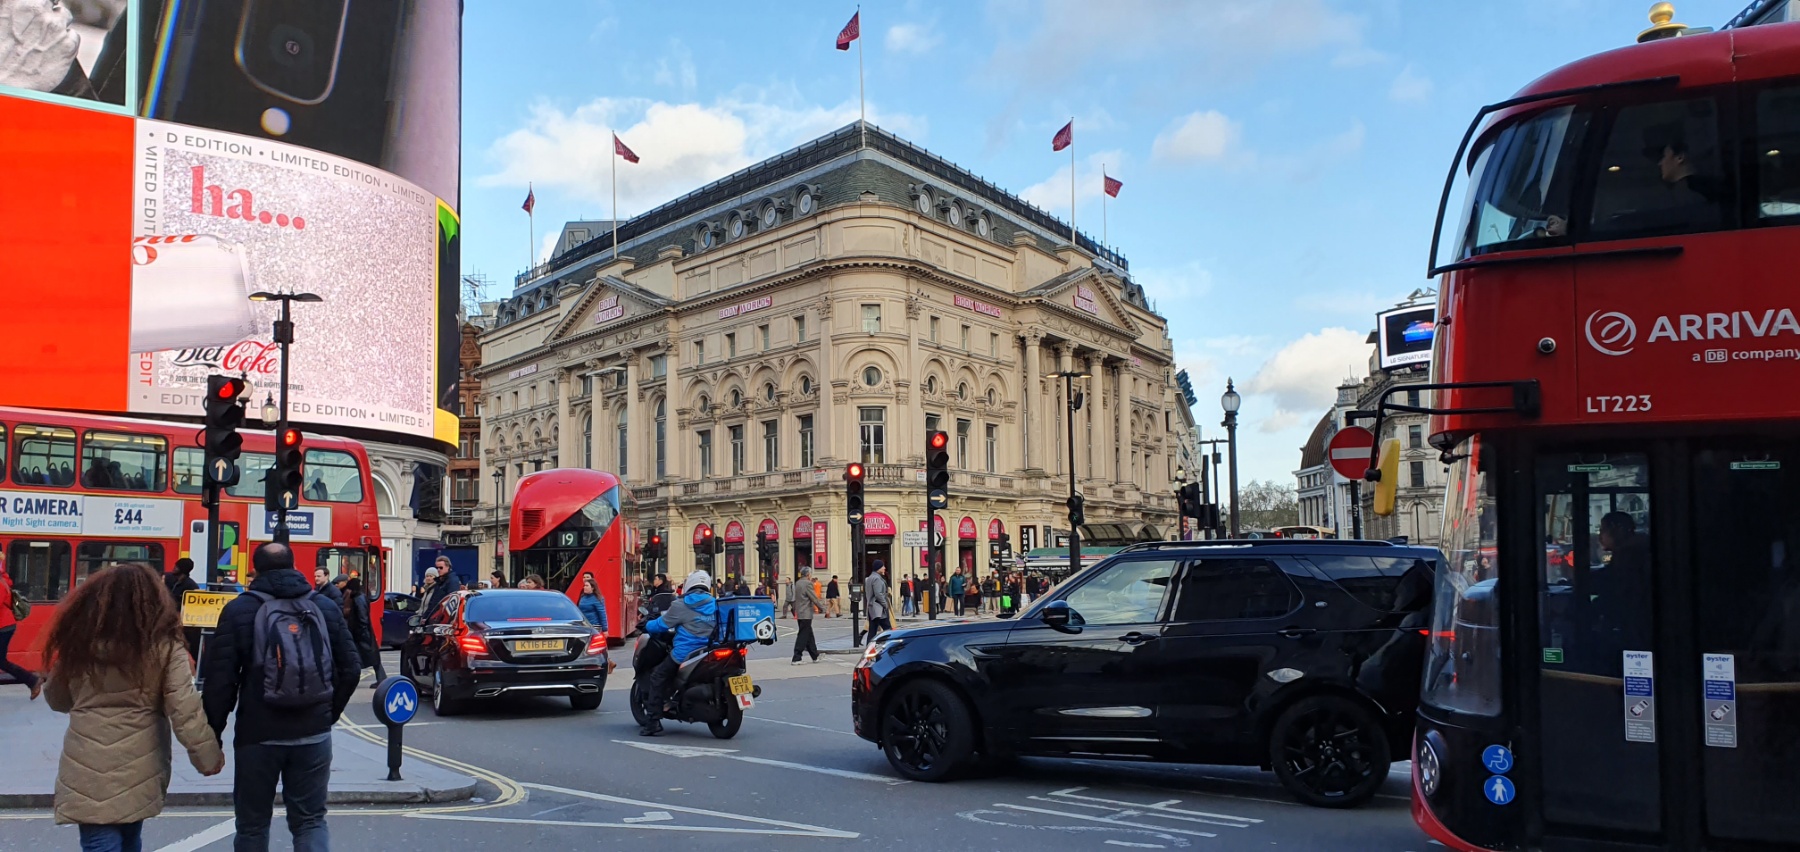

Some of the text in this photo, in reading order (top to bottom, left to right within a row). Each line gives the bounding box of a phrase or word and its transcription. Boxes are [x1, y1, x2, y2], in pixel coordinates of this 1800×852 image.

[185, 135, 252, 156] EDITION
[271, 150, 329, 172] LIMITED
[333, 165, 381, 188] EDITION
[392, 183, 426, 206] LIMITED
[599, 295, 619, 311] BODY
[719, 296, 772, 320] BODY WORLDS
[955, 296, 1001, 318] BODY WORLDS
[594, 305, 624, 324] WORLDS
[1647, 308, 1800, 343] ARRIVA
[222, 340, 278, 374] Coke
[1397, 353, 1430, 362] SIGNATURE
[1692, 352, 1701, 361] a
[1732, 348, 1800, 361] company
[160, 393, 204, 406] EDIT
[316, 404, 367, 419] EDITION
[379, 411, 417, 426] LIMITED
[1586, 395, 1652, 413] LT223
[13, 497, 83, 516] CAMERA.
[2, 517, 79, 528] Night Sight camera.
[114, 508, 143, 525] £44
[562, 533, 574, 546] 19
[520, 640, 559, 650] KT16 FBZ
[740, 695, 751, 706] L
